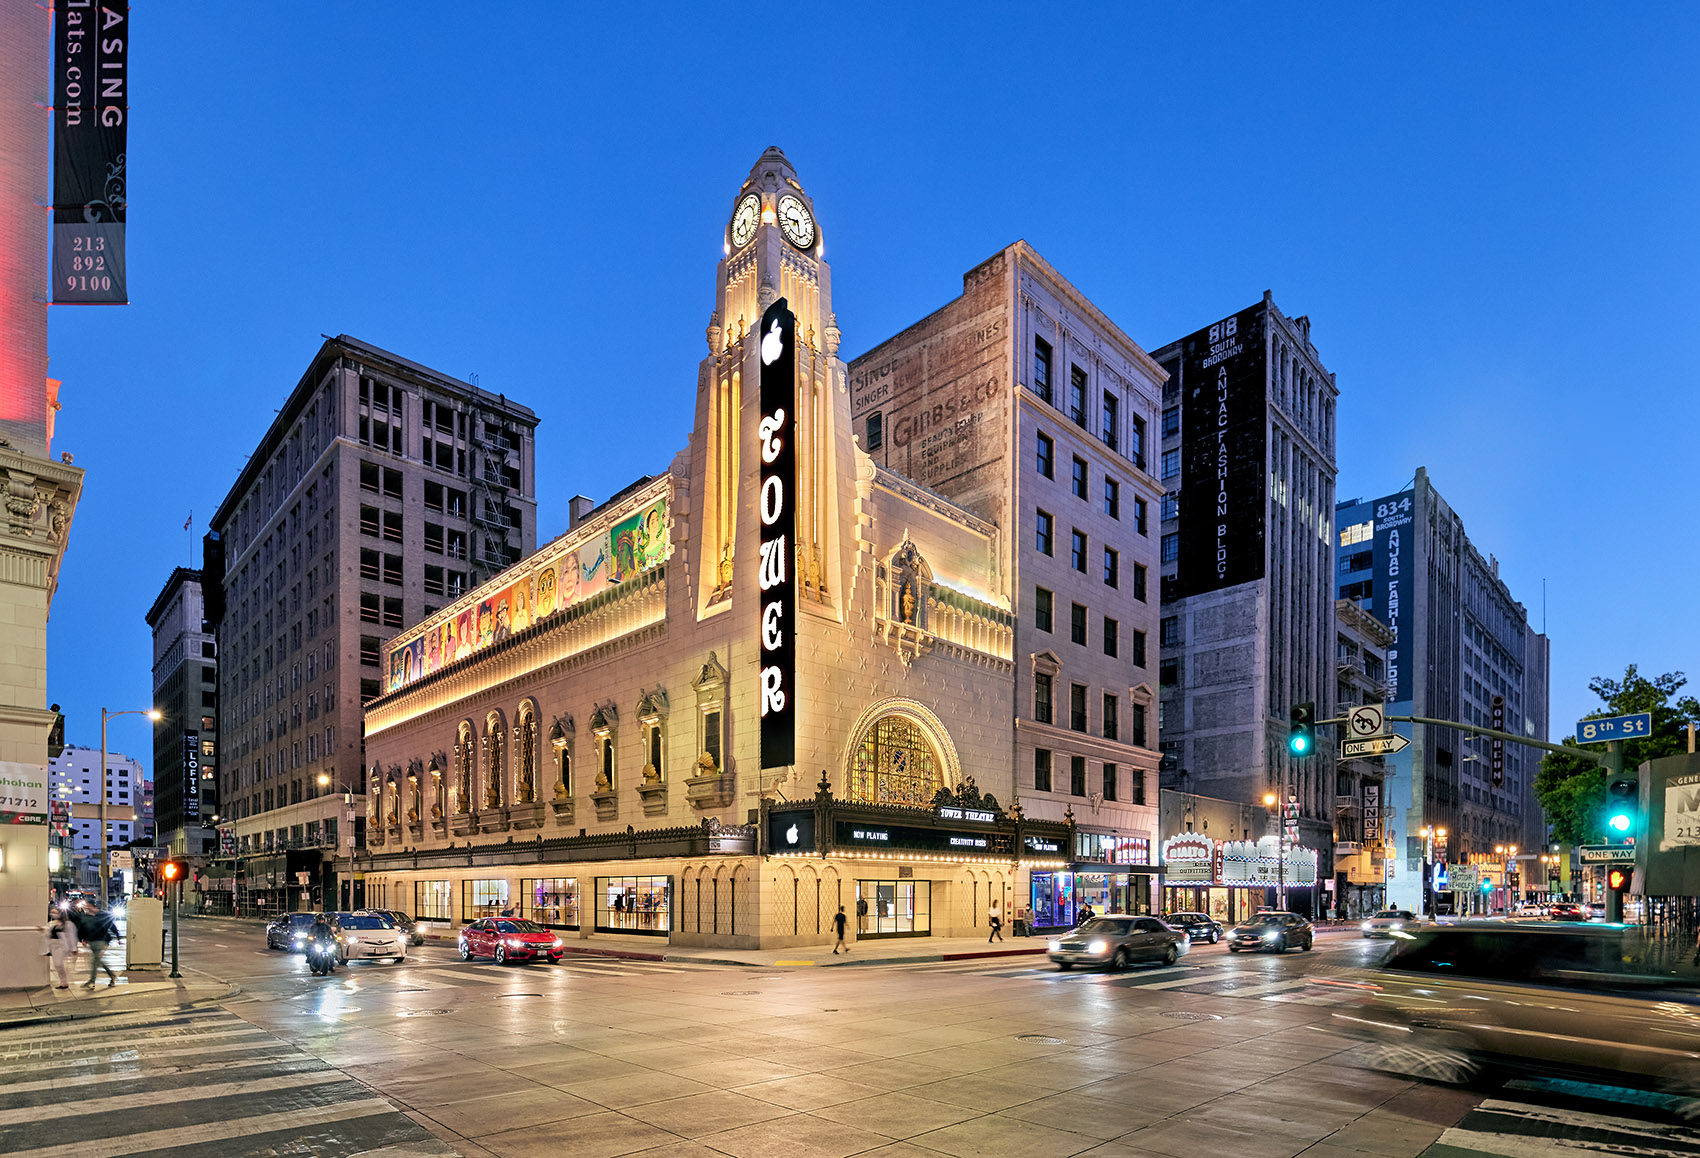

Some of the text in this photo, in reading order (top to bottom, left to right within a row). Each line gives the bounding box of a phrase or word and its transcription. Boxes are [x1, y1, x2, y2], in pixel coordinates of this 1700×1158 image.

[73, 237, 105, 251] 213
[73, 256, 105, 271] 892
[67, 276, 111, 291] 9100
[1209, 317, 1237, 344] 818
[1210, 337, 1235, 355] SOUTH
[1203, 344, 1243, 368] BROADWAY
[856, 384, 888, 410] SINGER
[960, 394, 971, 412] &
[1218, 366, 1228, 426] ANJAC
[1217, 428, 1228, 517] FASHION
[1377, 497, 1412, 518] 834
[1383, 513, 1404, 523] SOUTH
[1389, 530, 1399, 576] ANJAC
[758, 407, 786, 718] TOWER
[1583, 719, 1644, 738] 8th St
[1346, 740, 1393, 753] ONE WAY
[188, 752, 198, 794] LOFTS
[940, 809, 994, 822] TOWER THEATRE
[1364, 786, 1379, 839] LYNNS
[853, 830, 888, 841] NOW PLAYING
[1169, 846, 1206, 858] RIALTO
[1588, 850, 1633, 859] ONE WAY
